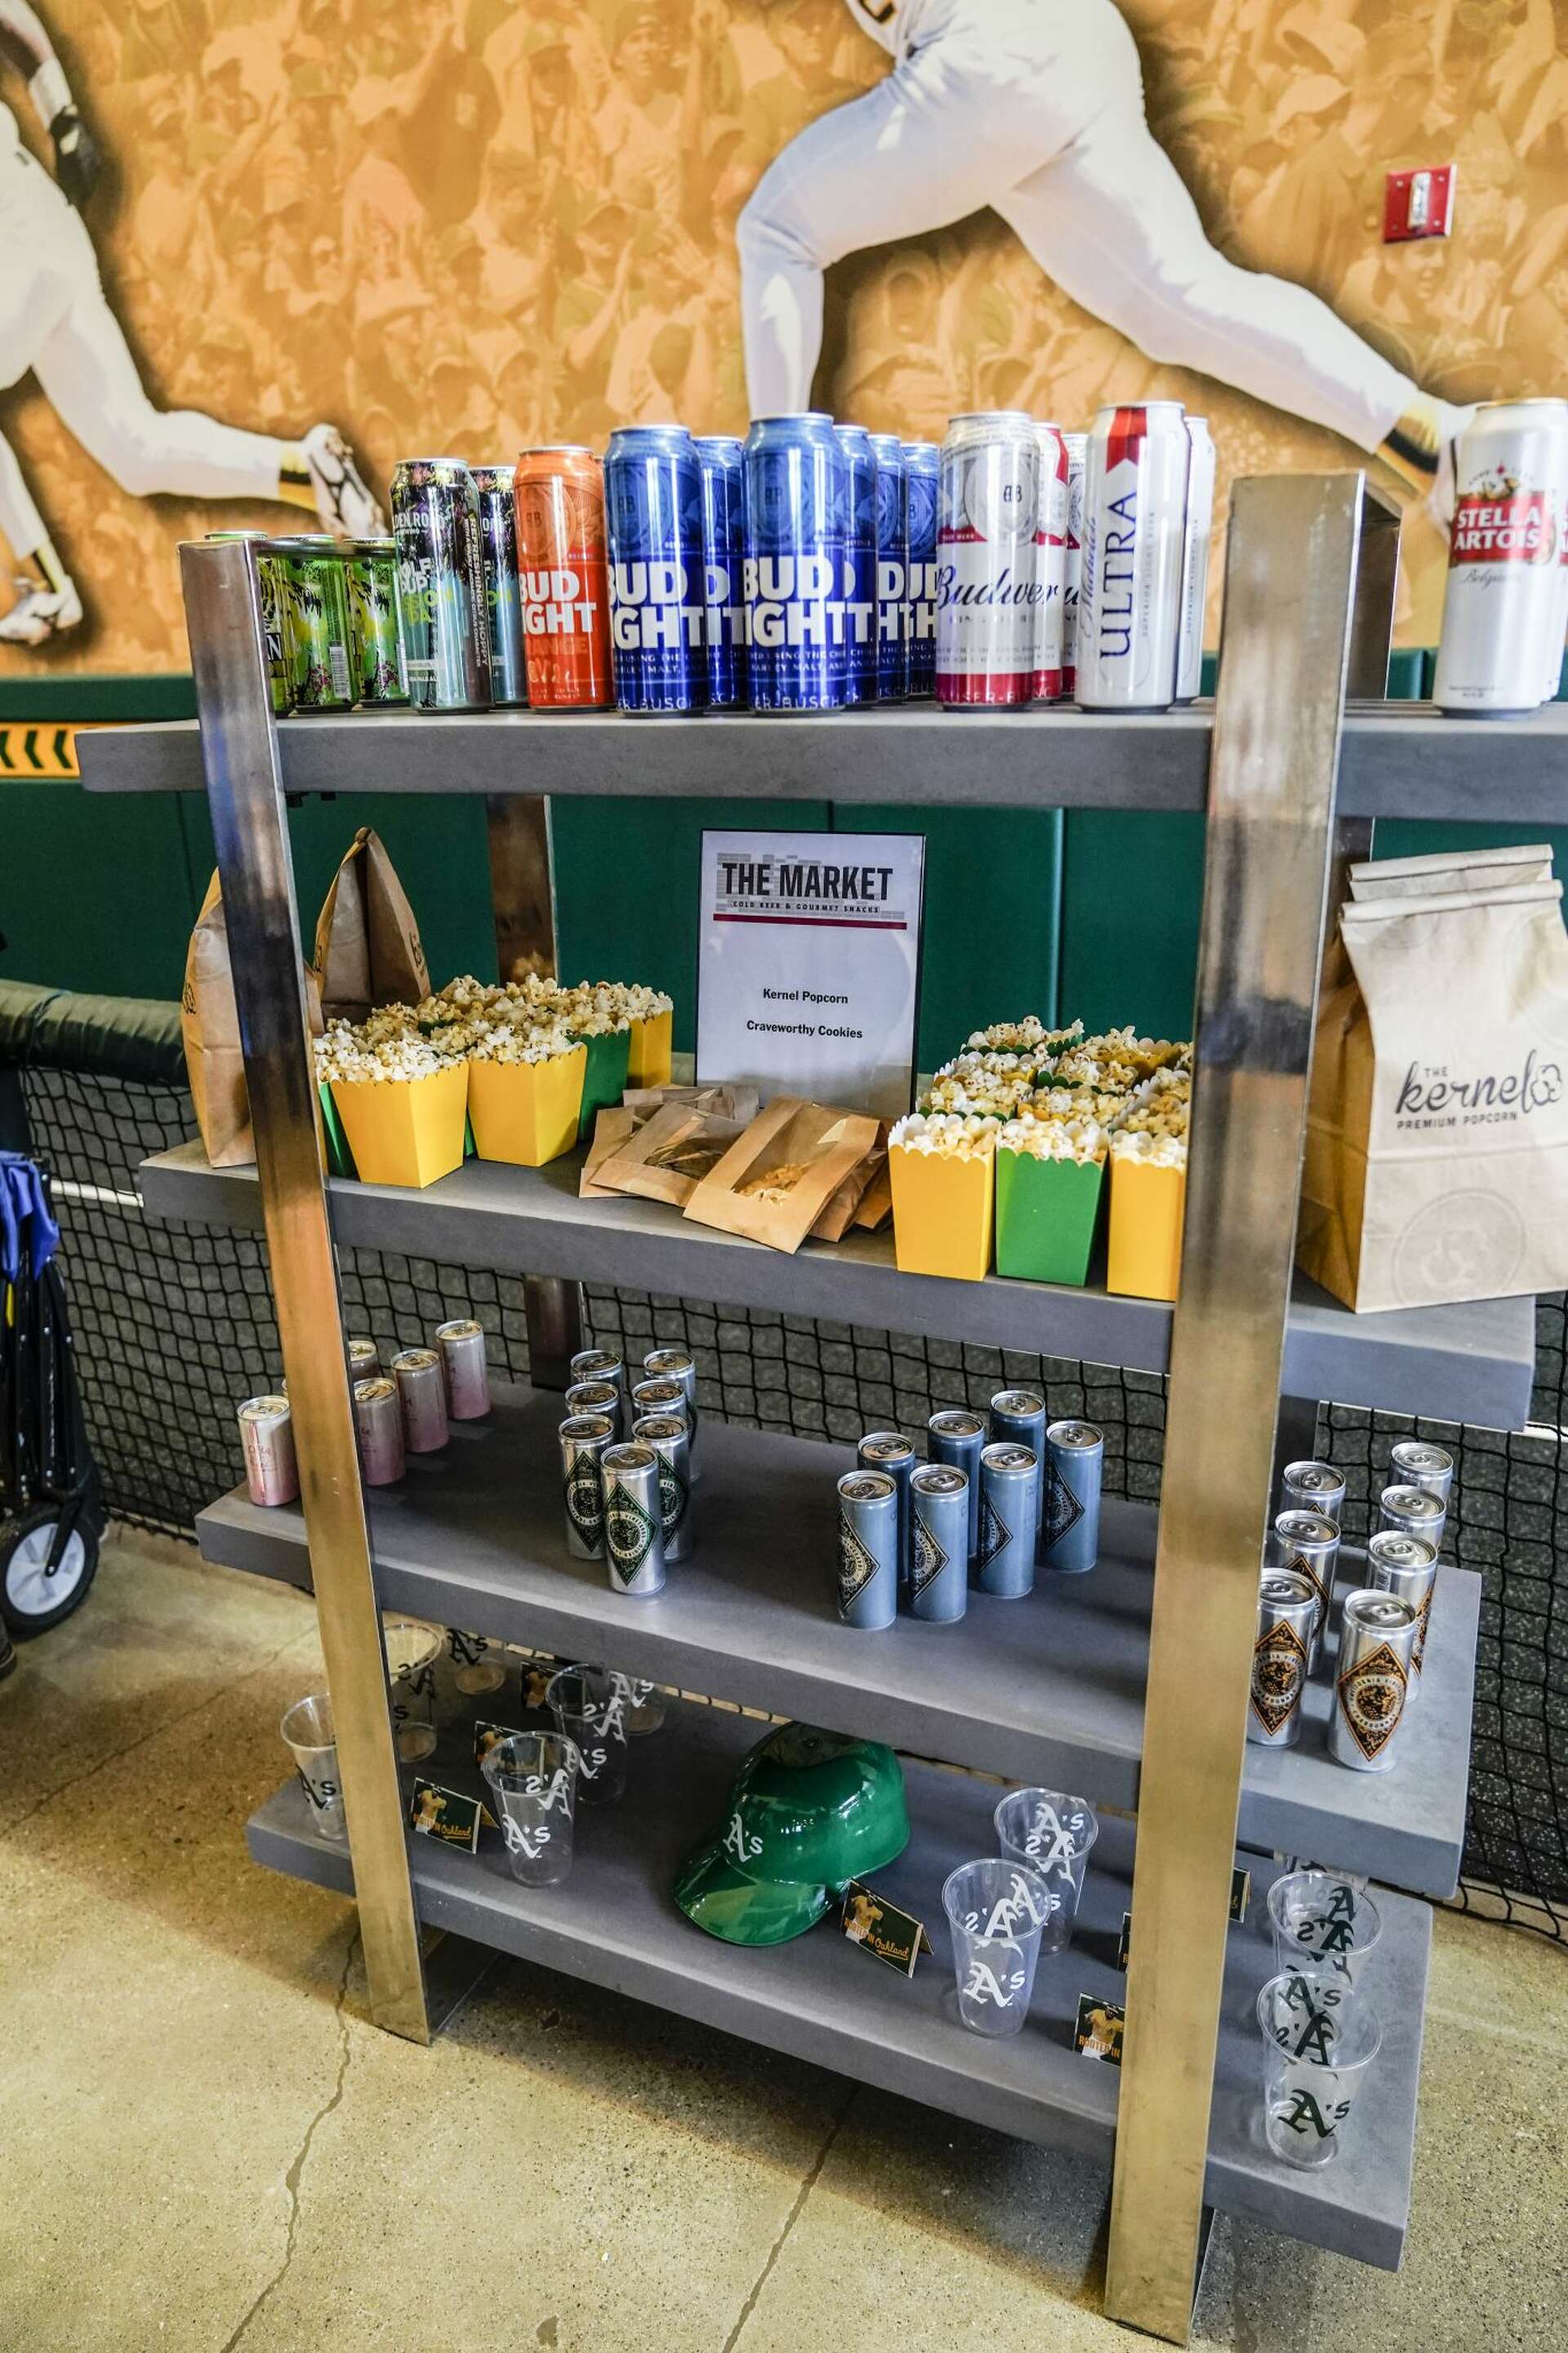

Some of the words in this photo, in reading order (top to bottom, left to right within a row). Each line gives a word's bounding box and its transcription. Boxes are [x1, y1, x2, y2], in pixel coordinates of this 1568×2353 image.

[1457, 506, 1542, 529] STELLA
[1454, 529, 1541, 550] ARTOIS
[519, 570, 581, 603] BUD
[608, 561, 688, 606] BUD
[743, 555, 835, 602] BUD
[1099, 490, 1138, 658] ULTRA
[479, 620, 489, 666] HOPPY
[745, 601, 846, 648] IGHT
[722, 862, 770, 896] THE
[779, 865, 893, 900] MARKET
[796, 903, 840, 911] GOURMET
[844, 906, 880, 914] SNACKS
[763, 988, 800, 1001] Kernel
[802, 991, 849, 1004] Popcorn
[746, 1020, 816, 1036] Craveworthy
[818, 1025, 863, 1038] Cookies
[1395, 1049, 1537, 1115] kernel
[1423, 1066, 1449, 1079] THE
[1396, 1116, 1456, 1131] PREMIUM
[1463, 1111, 1518, 1126] POPCORN
[501, 1814, 551, 1859] A's
[723, 1812, 764, 1863] A's
[875, 1938, 910, 1958] Oakland
[963, 1961, 1026, 2008] A's
[1278, 2088, 1351, 2138] A's
